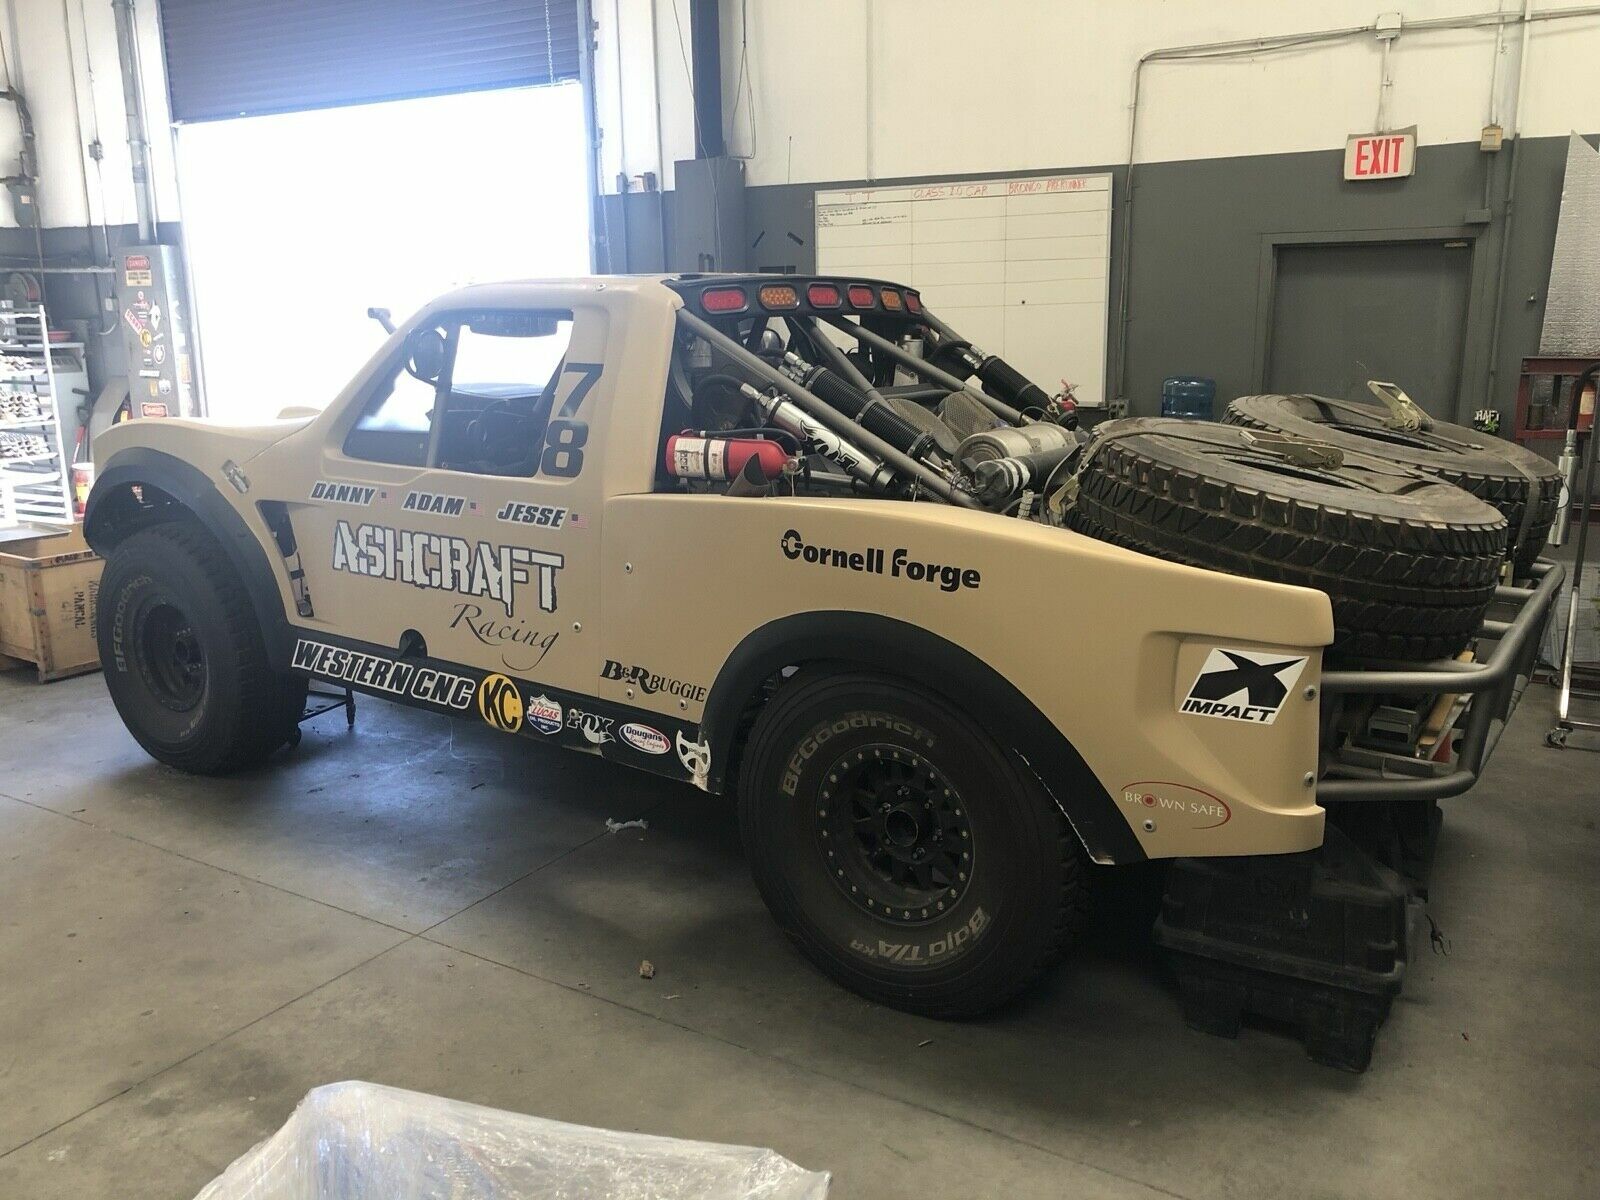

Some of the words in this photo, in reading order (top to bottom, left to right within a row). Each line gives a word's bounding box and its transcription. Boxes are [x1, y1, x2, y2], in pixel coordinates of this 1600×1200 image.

[1355, 137, 1404, 176] EXIT
[913, 187, 945, 199] CLASS
[966, 184, 988, 197] CAR
[1008, 181, 1042, 195] BRONCO
[311, 482, 375, 504] DANNY
[403, 491, 465, 516] ADAM
[497, 502, 566, 528] JESSE
[333, 520, 564, 618] ASHCRAFT
[781, 529, 884, 575] Cornell
[891, 548, 981, 593] Forge
[449, 603, 560, 671] Racing
[292, 639, 414, 695] WESTERN
[411, 668, 476, 710] CNC
[482, 677, 518, 730] KC
[531, 706, 560, 720] LUCAS
[1181, 699, 1276, 723] IMPACT
[567, 709, 615, 734] FOX
[626, 726, 663, 742] Dougans
[1125, 791, 1185, 812] BROWN
[1190, 802, 1225, 818] SAFE
[929, 907, 989, 958] Baja
